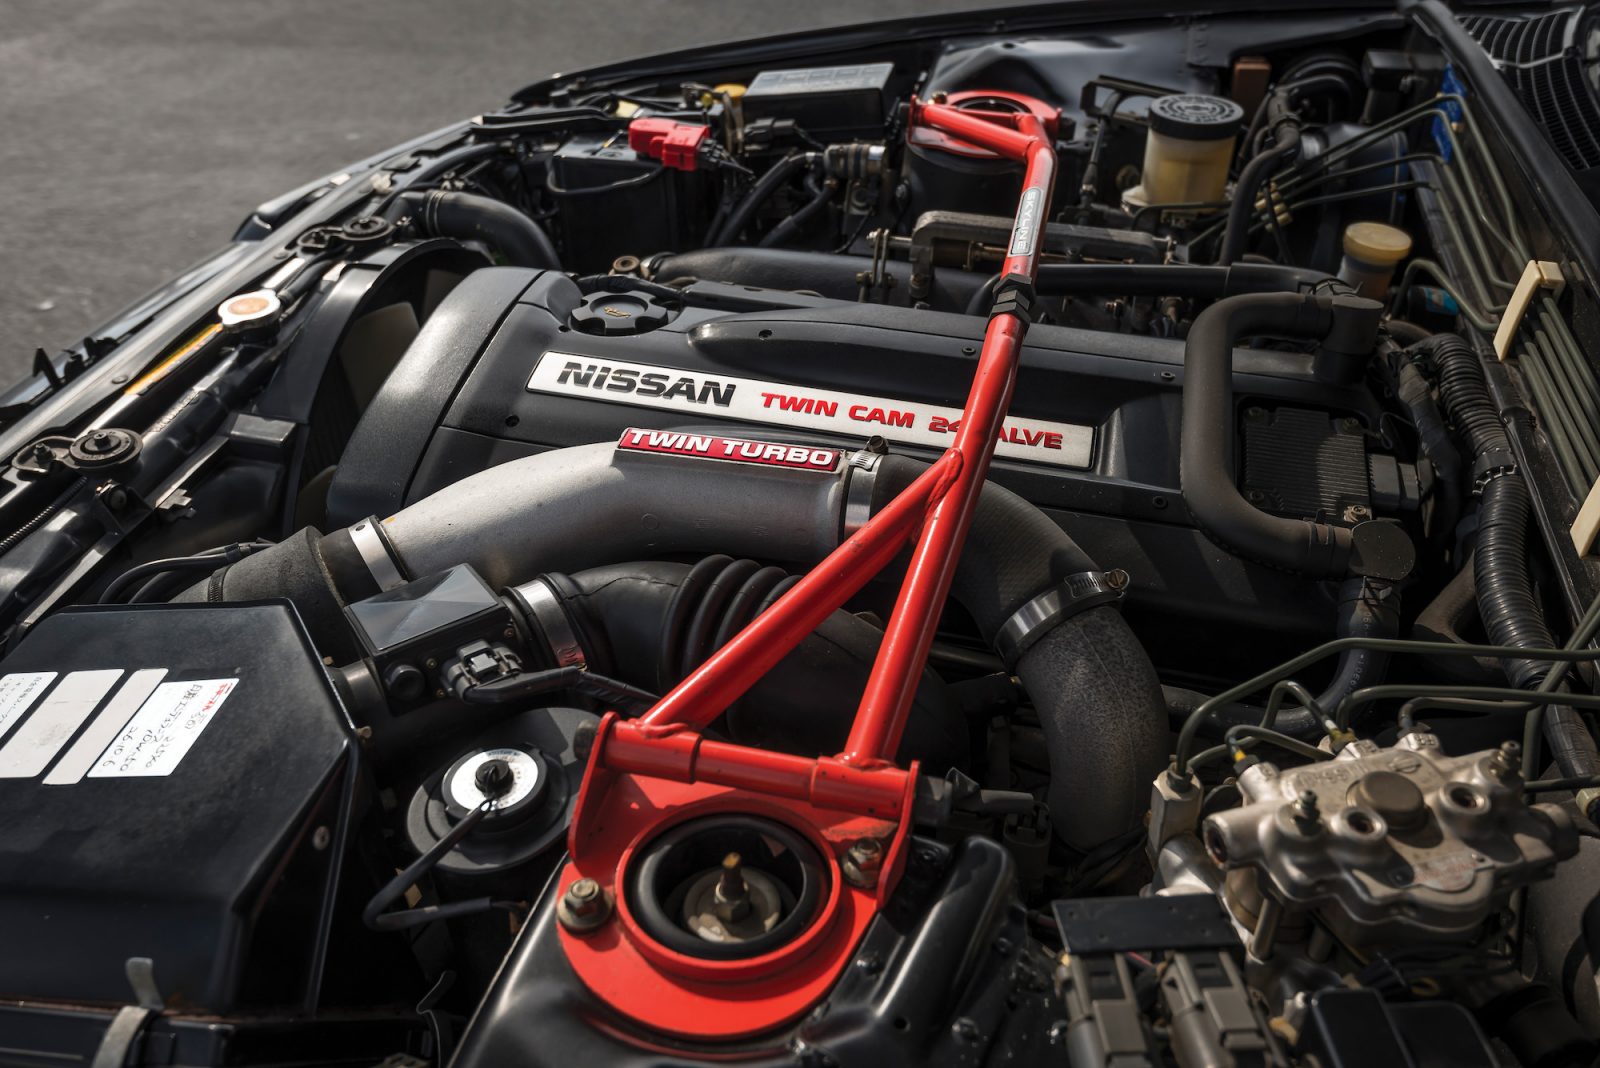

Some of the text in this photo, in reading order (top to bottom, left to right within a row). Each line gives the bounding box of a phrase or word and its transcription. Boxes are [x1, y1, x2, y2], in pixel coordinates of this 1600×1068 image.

[1016, 191, 1037, 251] SKYLINE
[556, 361, 737, 408] NISSAN
[760, 392, 838, 417] TWIN
[848, 404, 915, 429] CAM
[630, 429, 834, 466] TWIN TURBO
